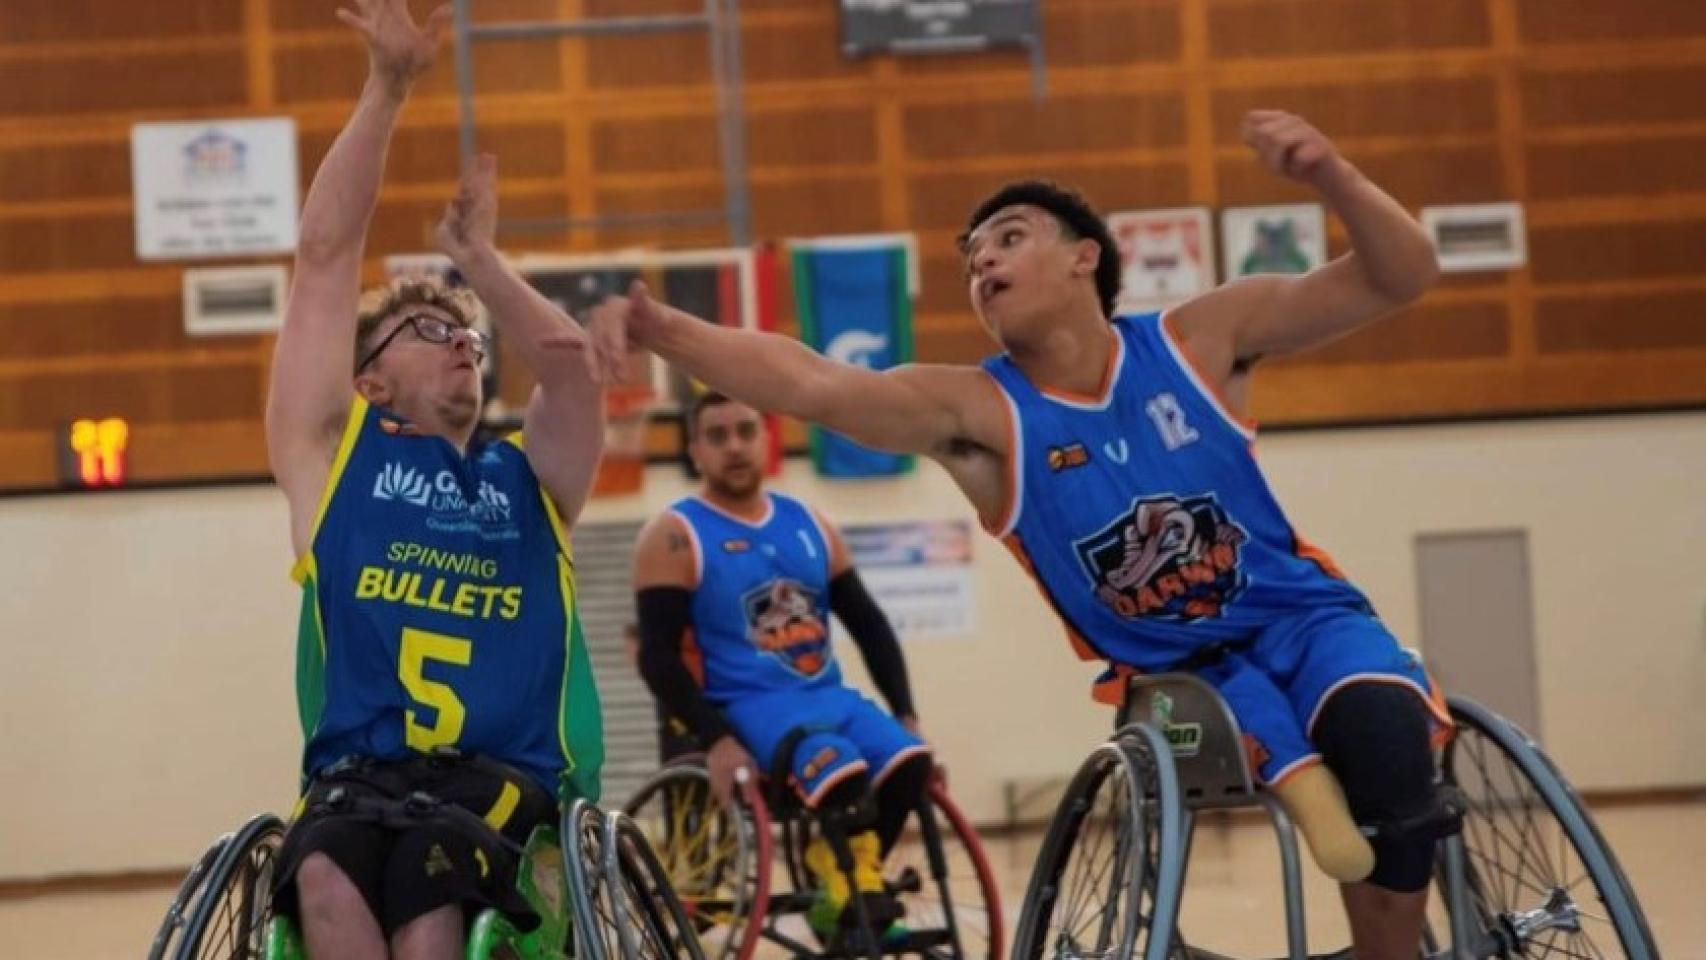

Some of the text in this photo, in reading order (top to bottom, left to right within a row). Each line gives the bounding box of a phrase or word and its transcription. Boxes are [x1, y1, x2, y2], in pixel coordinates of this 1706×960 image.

[1146, 392, 1199, 450] 12
[355, 566, 522, 620] BULLETS
[398, 627, 472, 754] 5
